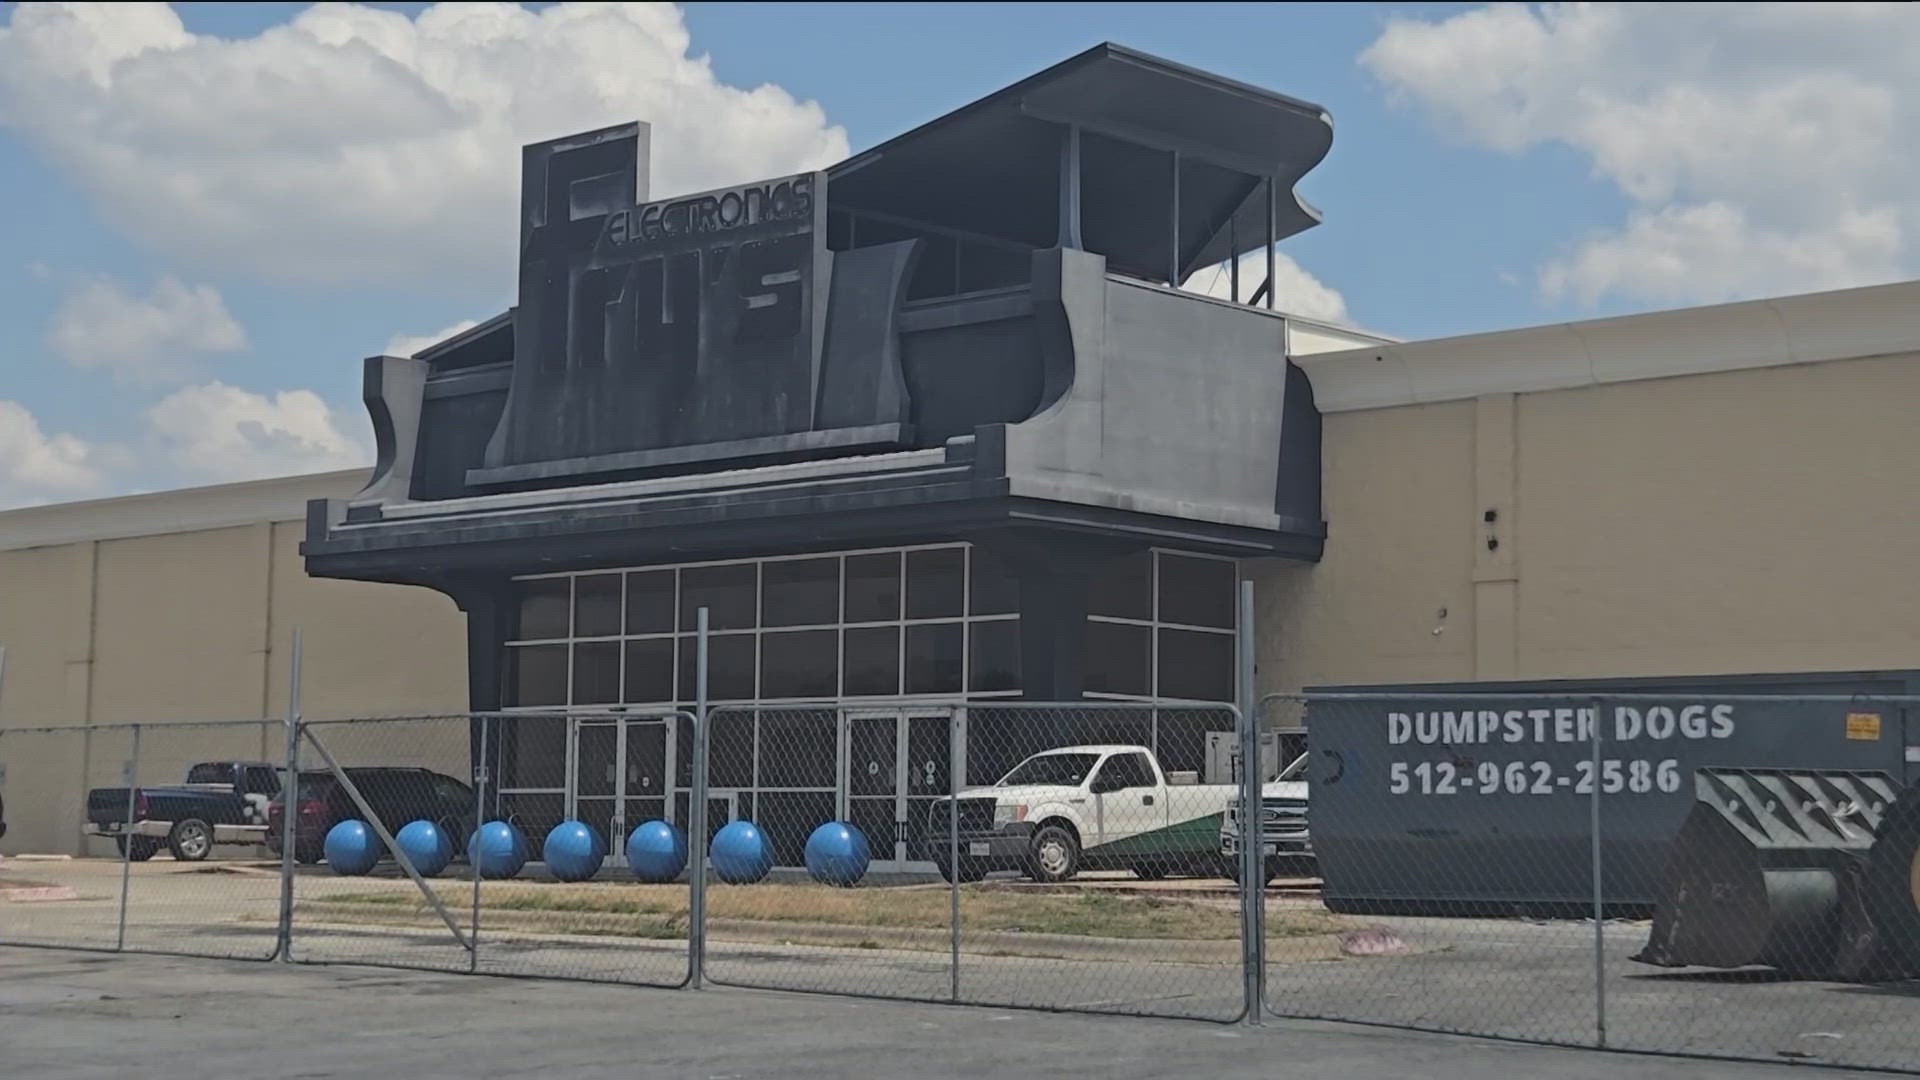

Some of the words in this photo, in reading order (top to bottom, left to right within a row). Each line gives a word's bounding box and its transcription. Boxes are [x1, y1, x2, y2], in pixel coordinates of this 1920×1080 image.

[606, 176, 811, 246] ELECTRONICS
[1388, 709, 1602, 744] DUMPSTER
[1614, 704, 1735, 741] DOGS
[1389, 759, 1681, 795] 512-962-2586
